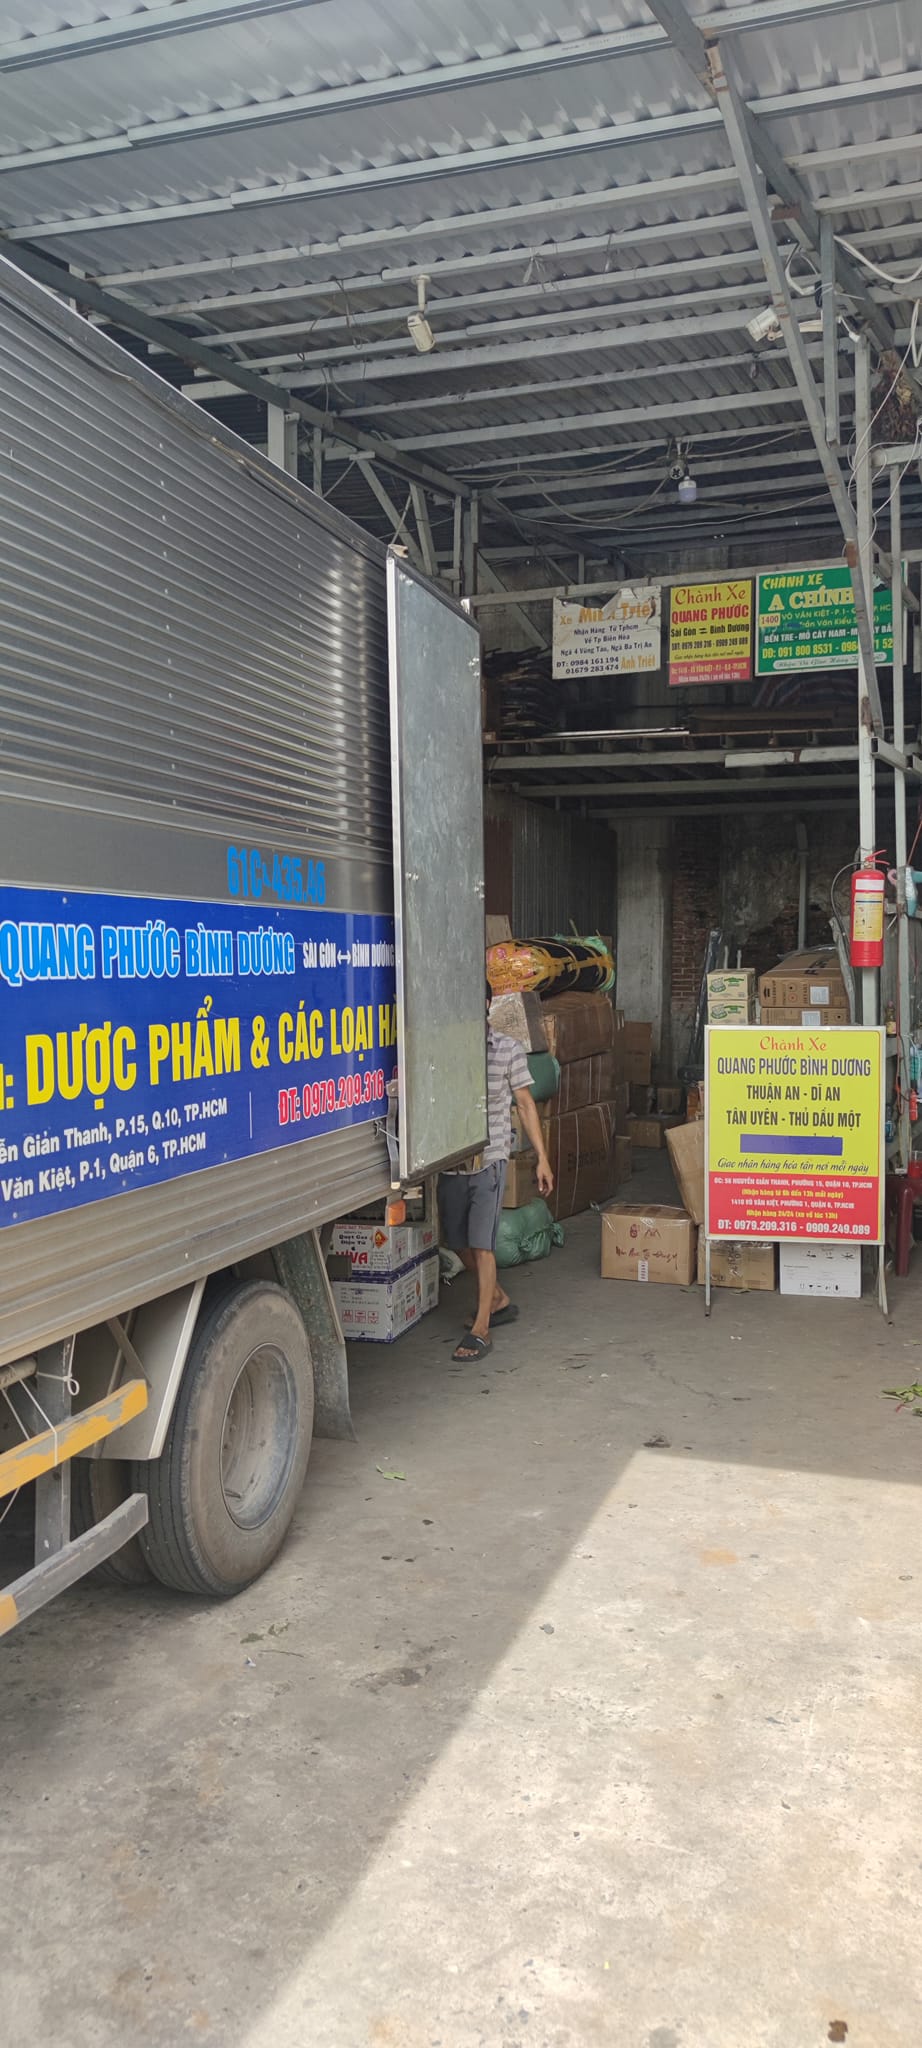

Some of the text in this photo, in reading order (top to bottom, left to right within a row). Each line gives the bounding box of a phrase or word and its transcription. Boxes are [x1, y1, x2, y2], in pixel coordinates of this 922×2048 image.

[762, 573, 823, 590] CHÀNH XE
[675, 584, 746, 605] Chành Xe
[768, 596, 785, 611] A
[560, 615, 573, 626] Xe
[671, 603, 749, 625] QUANG PHƯỚC
[761, 613, 780, 625] 1400
[781, 632, 795, 642] TRE
[828, 628, 846, 638] NAM
[778, 646, 793, 657] 091
[796, 644, 811, 656] 800
[813, 642, 833, 655] 8531
[591, 657, 604, 665] 161
[606, 656, 619, 664] 194
[621, 656, 636, 669] Anh
[565, 666, 589, 675] 01679
[590, 664, 604, 673] 283
[0, 919, 296, 986] QUANG PHƯỚC BÌNH DƯƠNG
[303, 937, 396, 969] SÀI GÒN BÌNH DƯƠNG
[759, 1035, 828, 1052] Chành Xe
[25, 1020, 138, 1111] DƯỢC
[148, 994, 242, 1087] PHẨM
[250, 1014, 271, 1070] &
[278, 1000, 324, 1065] CÁC
[330, 1004, 374, 1062] LOẠI
[717, 1054, 872, 1077] QUANG PHƯỚC BÌNH DƯƠNG
[278, 1067, 385, 1126] ĐT: 0979.209.316
[746, 1082, 841, 1104] THUẬN AN DĨ AN
[726, 1106, 862, 1132] TÂN UYÊN THỦ DẤU MỘT
[23, 1130, 61, 1160] Giản
[64, 1121, 113, 1149] Thanh,
[115, 1114, 149, 1138] P.15,
[151, 1107, 182, 1130] Q.10,
[183, 1096, 228, 1123] TP.HCM
[1, 1131, 207, 1202] Văn Kiệt, P.1, Quận 6, TP.HCM
[760, 1159, 782, 1173] hàng
[847, 1162, 870, 1175] ngày
[734, 1219, 797, 1233] 0979.209.316
[806, 1222, 871, 1236] 0909.249.089
